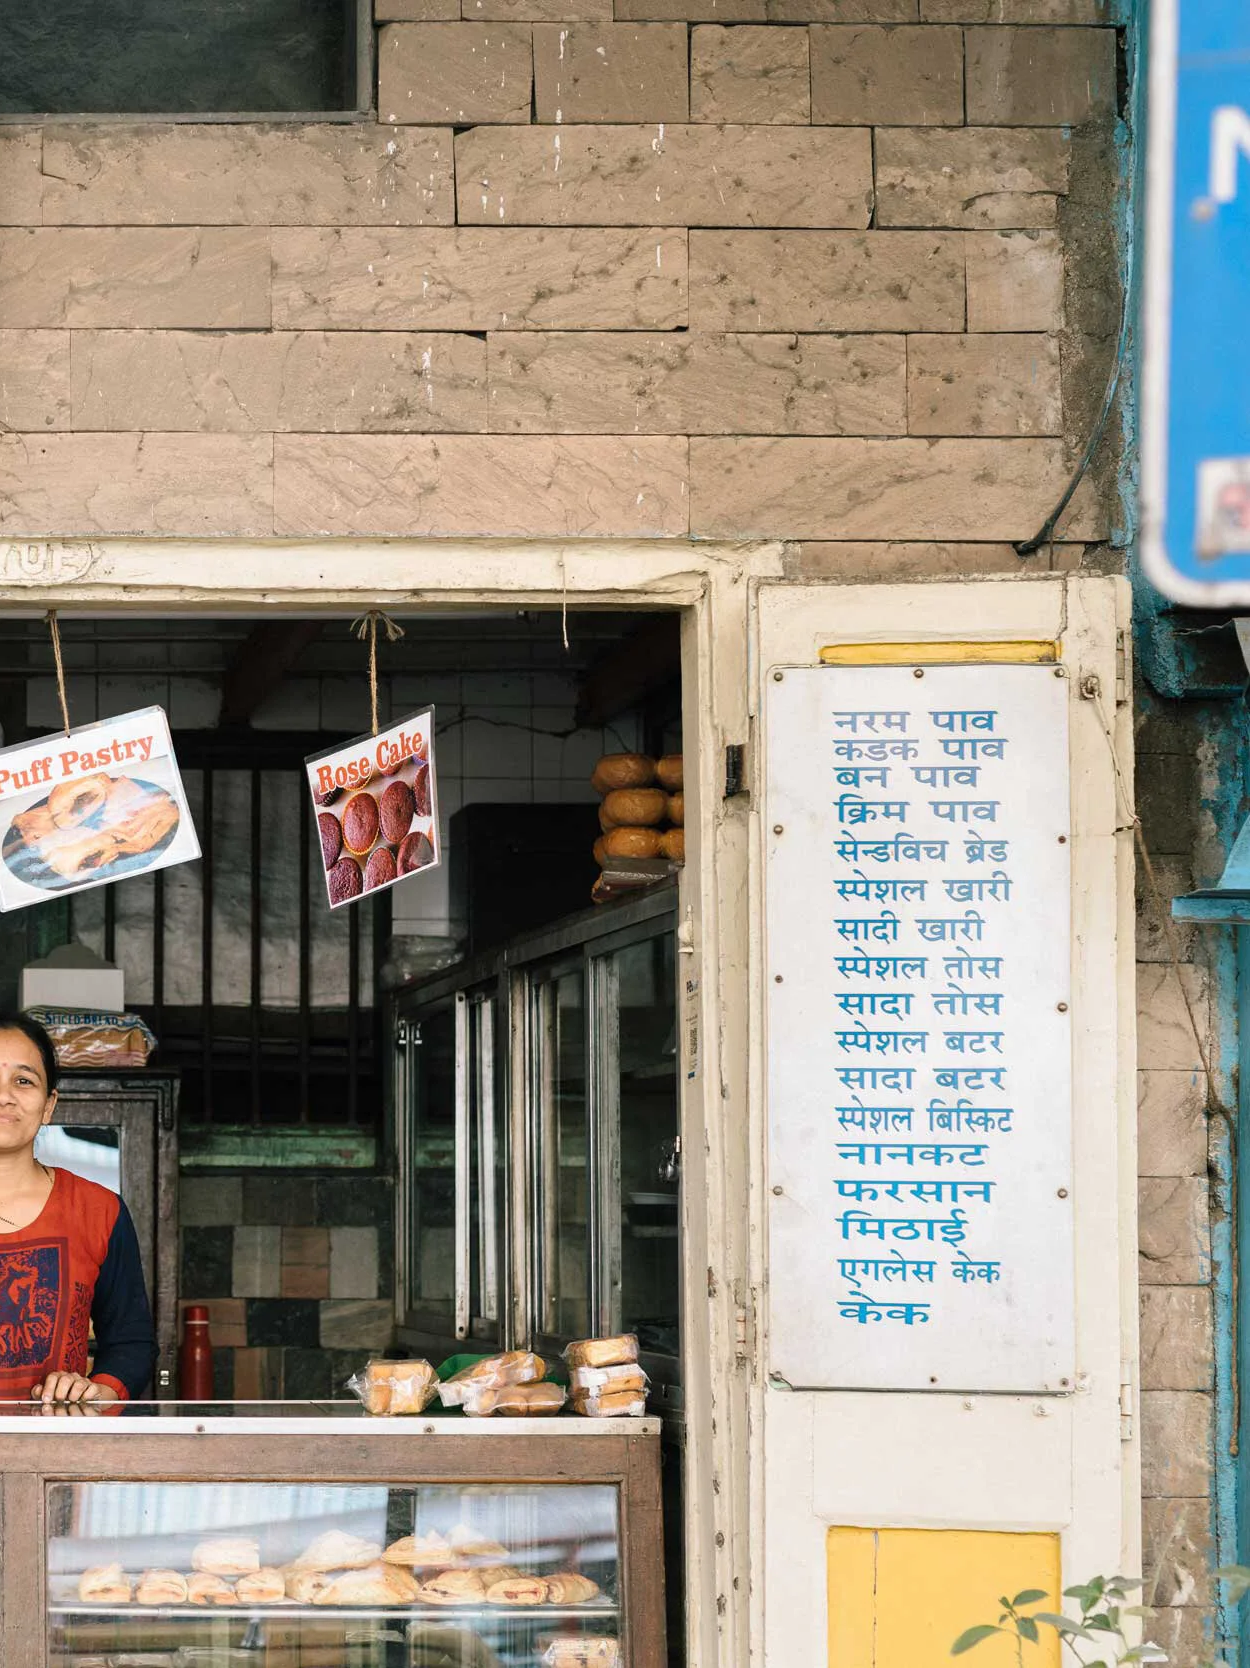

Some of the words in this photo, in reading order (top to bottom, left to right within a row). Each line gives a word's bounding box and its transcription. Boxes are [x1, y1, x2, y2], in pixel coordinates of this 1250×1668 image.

[832, 712, 911, 733] नरम
[928, 711, 998, 732] पाव
[61, 735, 154, 777] Pastry
[316, 757, 371, 794] Rose
[376, 729, 424, 769] Cake
[832, 739, 919, 761] कडक
[938, 738, 1009, 760] पाव
[832, 767, 892, 789] बन
[909, 766, 982, 788] पाव
[832, 793, 910, 825] क्रिम
[928, 801, 1001, 823] पाव
[833, 830, 950, 863] सेन्डविच
[963, 830, 1009, 864] ब्रेड
[833, 869, 929, 904] स्पेशल
[942, 871, 1014, 902] खारी
[833, 910, 902, 944] सादी
[914, 910, 986, 941] खारी
[833, 946, 929, 981] स्पेशल
[942, 946, 1004, 979] तोस
[833, 993, 915, 1022] सादा
[930, 983, 1004, 1016] तोस
[834, 1020, 930, 1056] स्पेशल
[943, 1032, 1005, 1054] बटर
[834, 1068, 917, 1094] सादा
[932, 1067, 1007, 1090] बटर
[834, 1095, 915, 1134] स्पेशल
[926, 1098, 1014, 1133] बिस्किट
[835, 1143, 990, 1166] नानकट
[833, 1180, 997, 1203] फरसान
[834, 1208, 969, 1248] मिठाई
[836, 1249, 938, 1288] एगलेस
[950, 1250, 1001, 1284] केक
[836, 1290, 931, 1325] केक
